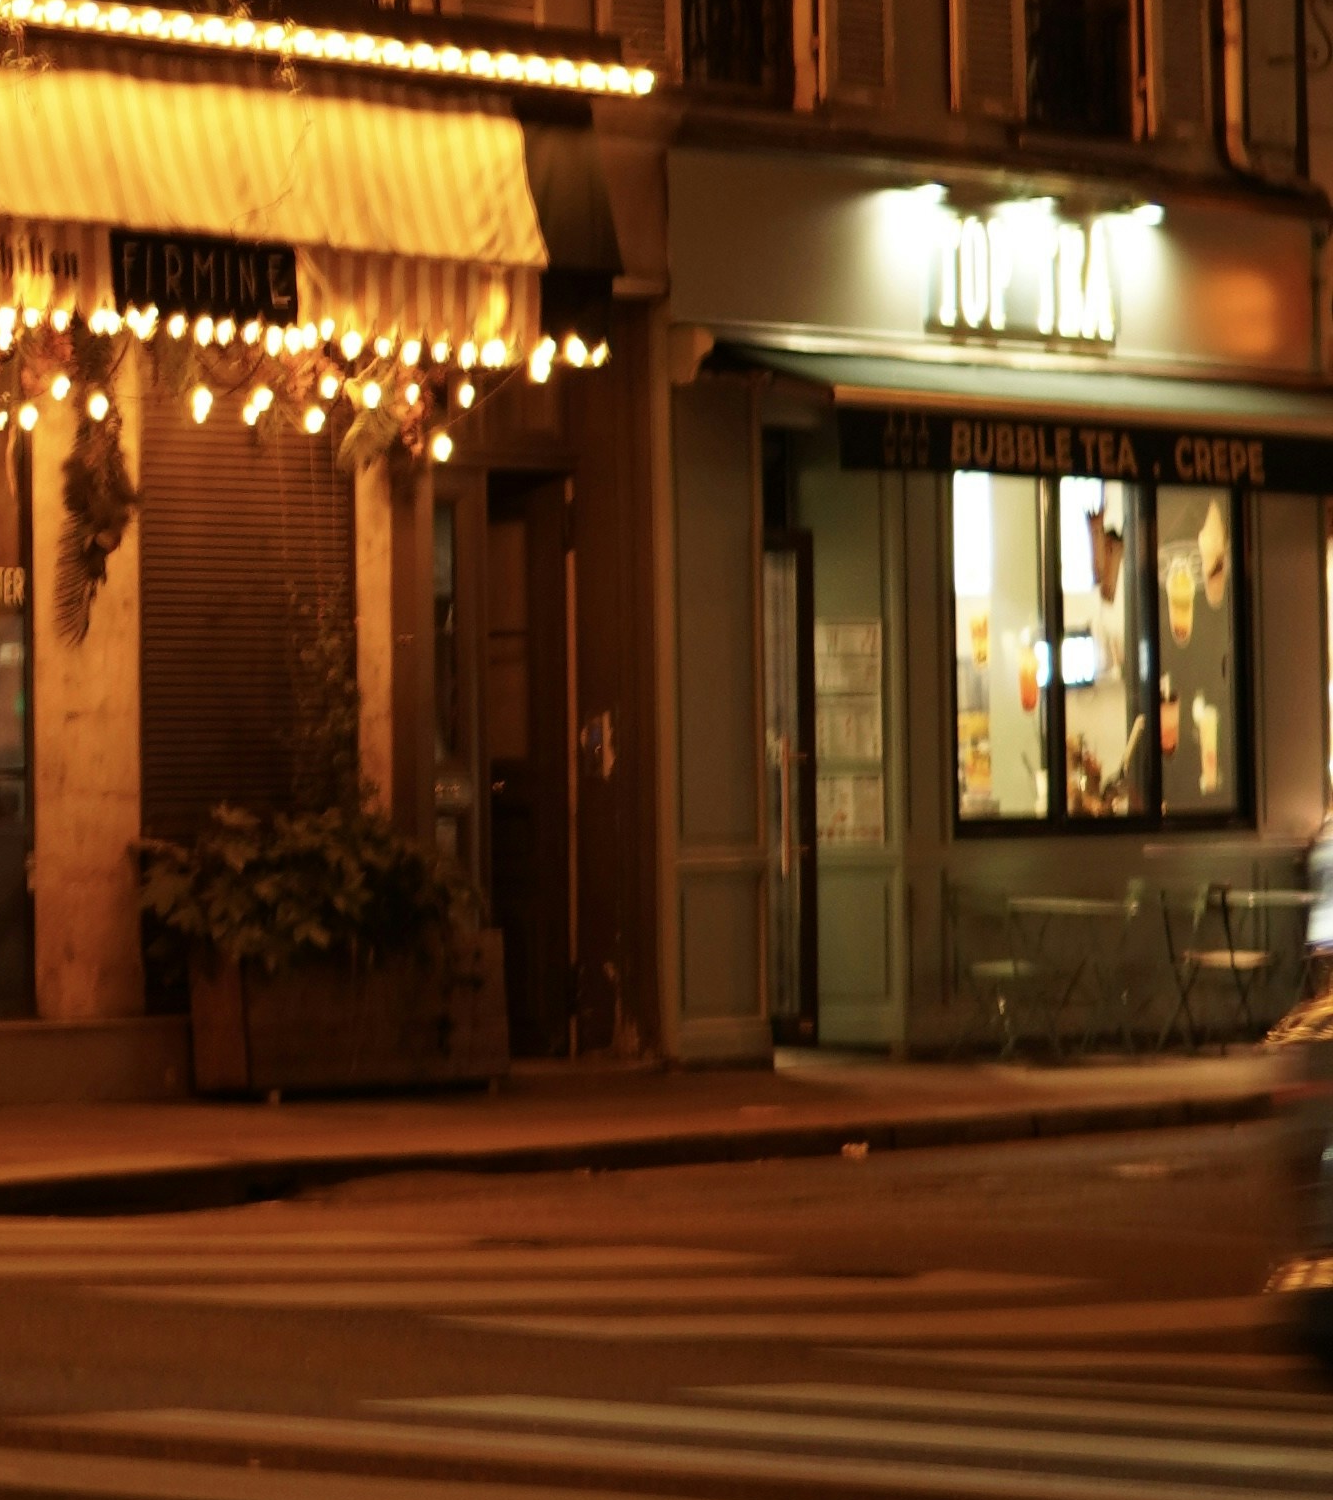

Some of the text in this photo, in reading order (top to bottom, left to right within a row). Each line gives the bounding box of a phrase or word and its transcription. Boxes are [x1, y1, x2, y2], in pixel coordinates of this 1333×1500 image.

[122, 241, 291, 309] FIRMINE
[951, 419, 1073, 472] BUBBLE
[1079, 427, 1138, 477] TEA
[1174, 435, 1266, 486] CREPE
